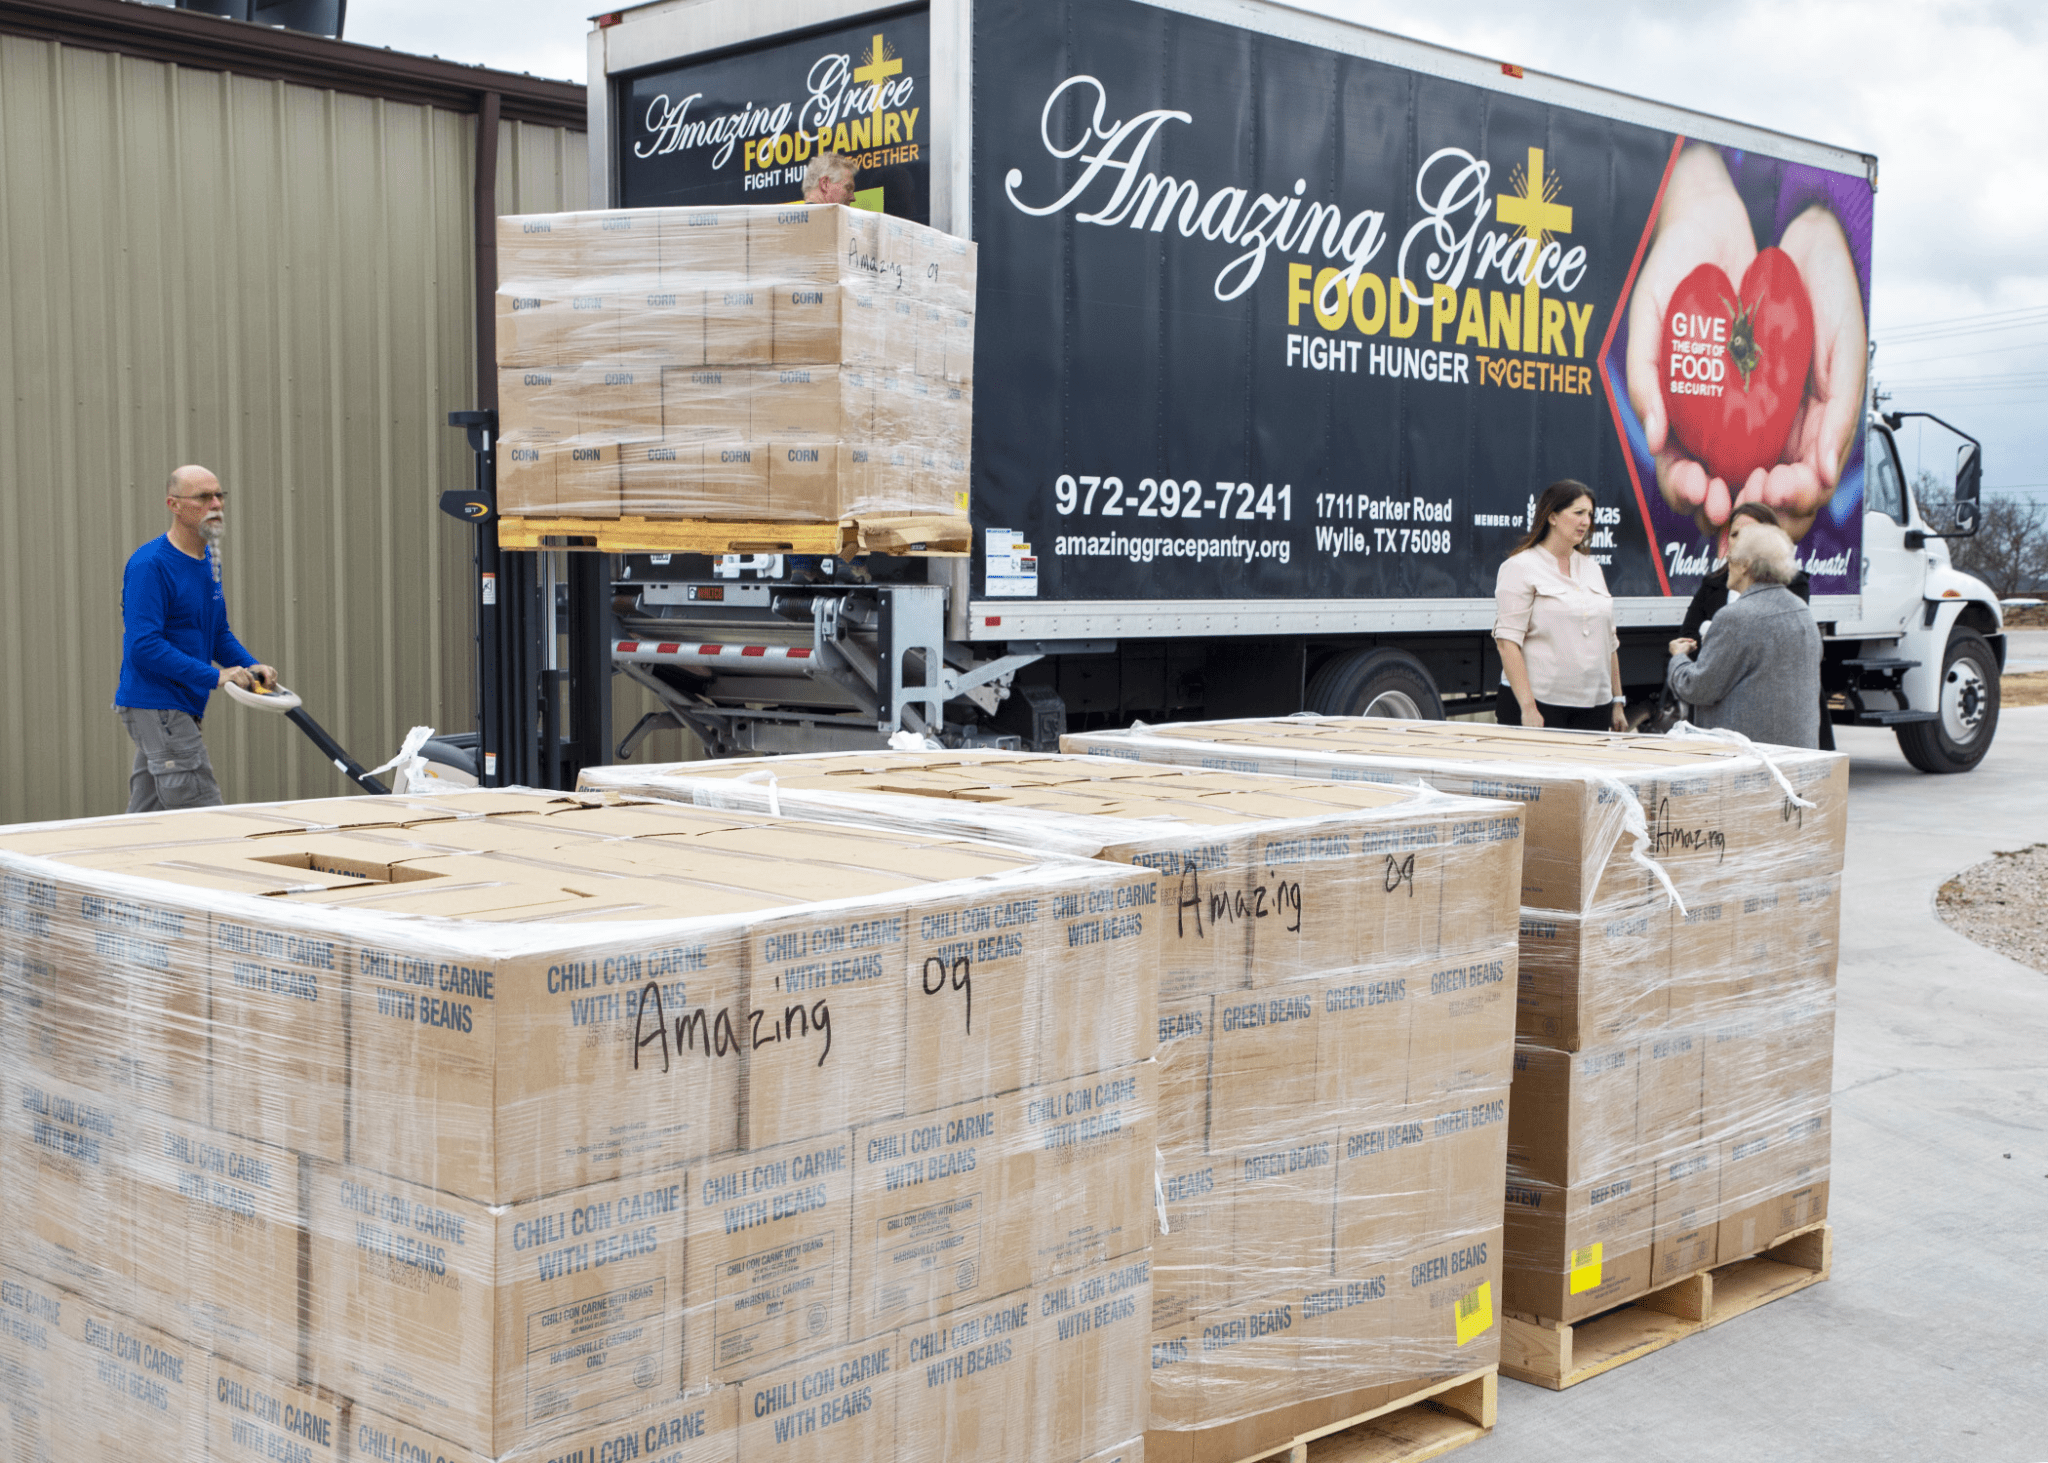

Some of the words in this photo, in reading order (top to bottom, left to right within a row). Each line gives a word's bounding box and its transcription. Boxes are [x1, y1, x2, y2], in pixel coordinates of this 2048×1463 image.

[634, 92, 793, 170] Amazing
[798, 54, 914, 141] Grace
[744, 131, 810, 172] FOOD
[744, 169, 780, 191] FIGHT
[1005, 74, 1387, 316] Amazing
[1398, 147, 1588, 305] Grace
[523, 221, 551, 234] CORN
[778, 211, 809, 225] CORN
[848, 237, 903, 290] Amazing
[927, 263, 939, 283] 09
[512, 298, 541, 310] CORN
[647, 294, 676, 307] CORN
[792, 292, 823, 305] CORN
[1288, 262, 1419, 339] FOOD
[1672, 312, 1726, 342] GIVE
[1287, 333, 1362, 373] FIGHT
[1369, 343, 1469, 384] HUNGER
[1672, 339, 1691, 353] THE
[1691, 342, 1712, 356] GIFT
[1712, 344, 1725, 357] OF
[524, 374, 552, 386] CORN
[605, 373, 633, 386] CORN
[692, 371, 722, 385] CORN
[779, 371, 811, 384] CORN
[1670, 353, 1725, 382] FOOD
[1670, 380, 1724, 397] SECURITY
[511, 449, 539, 462] CORN
[572, 449, 601, 462] CORN
[648, 448, 676, 461] CORN
[721, 450, 751, 463] CORN
[788, 449, 819, 463] CORN
[1055, 474, 1291, 521] 972-292-7241
[1316, 493, 1353, 519] 1711
[1357, 495, 1411, 522] Parker
[1414, 497, 1452, 522] Road
[1474, 514, 1510, 527] MEMBER
[1512, 515, 1523, 527] OF
[1055, 531, 1290, 564] amazinggracepantry.org
[1316, 526, 1370, 557] Wylie,
[1374, 528, 1397, 552] TX
[1400, 529, 1452, 554] 75098
[1665, 542, 1710, 577] Thank
[1804, 548, 1851, 576] donate!
[1331, 767, 1360, 781] BEEF
[1362, 771, 1394, 784] STEW
[1472, 780, 1503, 798] BEEF
[1506, 783, 1542, 802] STEW
[1452, 821, 1485, 846] GREEN
[1488, 817, 1520, 842] BEANS
[1656, 797, 1726, 863] Amazing
[1265, 840, 1306, 867] GREEN
[1310, 834, 1350, 858] BEANS
[1178, 860, 1302, 939] Amazing
[1385, 853, 1415, 898] 09
[1068, 921, 1100, 947] WITH
[1103, 913, 1142, 941] BEANS
[1520, 922, 1557, 939] STEW
[233, 961, 267, 992] WITH
[271, 968, 318, 1002] BEANS
[360, 947, 398, 981] CHILI
[403, 956, 435, 988] CON
[439, 962, 495, 1000] CARNE
[547, 959, 597, 995] CHILI
[603, 953, 642, 985] CON
[648, 944, 708, 978] CARNE
[785, 961, 828, 993] WITH
[831, 953, 882, 987] BEANS
[1431, 967, 1466, 995] GREEN
[1469, 960, 1503, 987] BEANS
[377, 986, 415, 1021] WITH
[420, 996, 473, 1034] BEANS
[1326, 984, 1365, 1012] GREEN
[1368, 978, 1406, 1007] BEANS
[634, 976, 832, 1073] Amazing
[922, 956, 971, 1036] 09
[1158, 1010, 1203, 1043] BEANS
[1223, 1002, 1266, 1032] GREEN
[1269, 994, 1311, 1025] BEANS
[1434, 1109, 1469, 1137] GREEN
[1471, 1099, 1504, 1128] BEANS
[1347, 1130, 1385, 1158] GREEN
[1388, 1119, 1423, 1149] BEANS
[702, 1170, 747, 1207] CHILI
[752, 1161, 787, 1192] CON
[792, 1145, 847, 1182] CARNE
[1245, 1152, 1286, 1182] GREEN
[1290, 1141, 1330, 1172] BEANS
[724, 1201, 767, 1235] WITH
[772, 1183, 826, 1223] BEANS
[1591, 1184, 1610, 1206] BEEF
[1611, 1179, 1632, 1200] STEW
[340, 1180, 376, 1216] CHILI
[381, 1192, 411, 1228] CON
[415, 1204, 465, 1245] CARNE
[513, 1208, 565, 1252] CHILI
[571, 1200, 612, 1237] CON
[617, 1185, 680, 1226] CARNE
[904, 1215, 917, 1227] CON
[938, 1204, 953, 1217] WITH
[537, 1243, 588, 1282] WITH
[595, 1225, 657, 1268] BEANS
[727, 1262, 745, 1276] CHILI
[746, 1257, 760, 1271] CON
[761, 1250, 783, 1265] CARNE
[784, 1245, 801, 1259] WITH
[1411, 1257, 1448, 1287] GREEN
[1451, 1242, 1487, 1274] BEANS
[735, 1286, 781, 1311] HARRISVILLE
[1041, 1287, 1075, 1317] CHILI
[1078, 1278, 1105, 1306] CON
[1109, 1260, 1149, 1294] CARNE
[1303, 1287, 1344, 1319] GREEN
[1347, 1275, 1386, 1306] BEANS
[541, 1312, 562, 1327] CHILI
[581, 1298, 607, 1315] CARNE
[766, 1300, 784, 1315] ONLY
[1057, 1311, 1091, 1341] WITH
[1094, 1294, 1135, 1328] BEANS
[909, 1331, 947, 1363] CHILI
[951, 1323, 980, 1351] CON
[984, 1303, 1028, 1340] CARNE
[1203, 1319, 1246, 1352] GREEN
[1250, 1304, 1292, 1338] BEANS
[85, 1318, 113, 1353] CHILI
[117, 1331, 141, 1365] CON
[144, 1344, 184, 1384] CARNE
[587, 1352, 608, 1368] ONLY
[927, 1355, 963, 1388] WITH
[967, 1338, 1012, 1376] BEANS
[754, 1380, 797, 1419] CHILI
[802, 1371, 836, 1402] CON
[839, 1347, 890, 1389] CARNE
[217, 1376, 250, 1412] CHILI
[254, 1391, 281, 1427] CON
[284, 1403, 331, 1448] CARNE
[774, 1404, 816, 1444] WITH
[820, 1386, 872, 1429] BEANS
